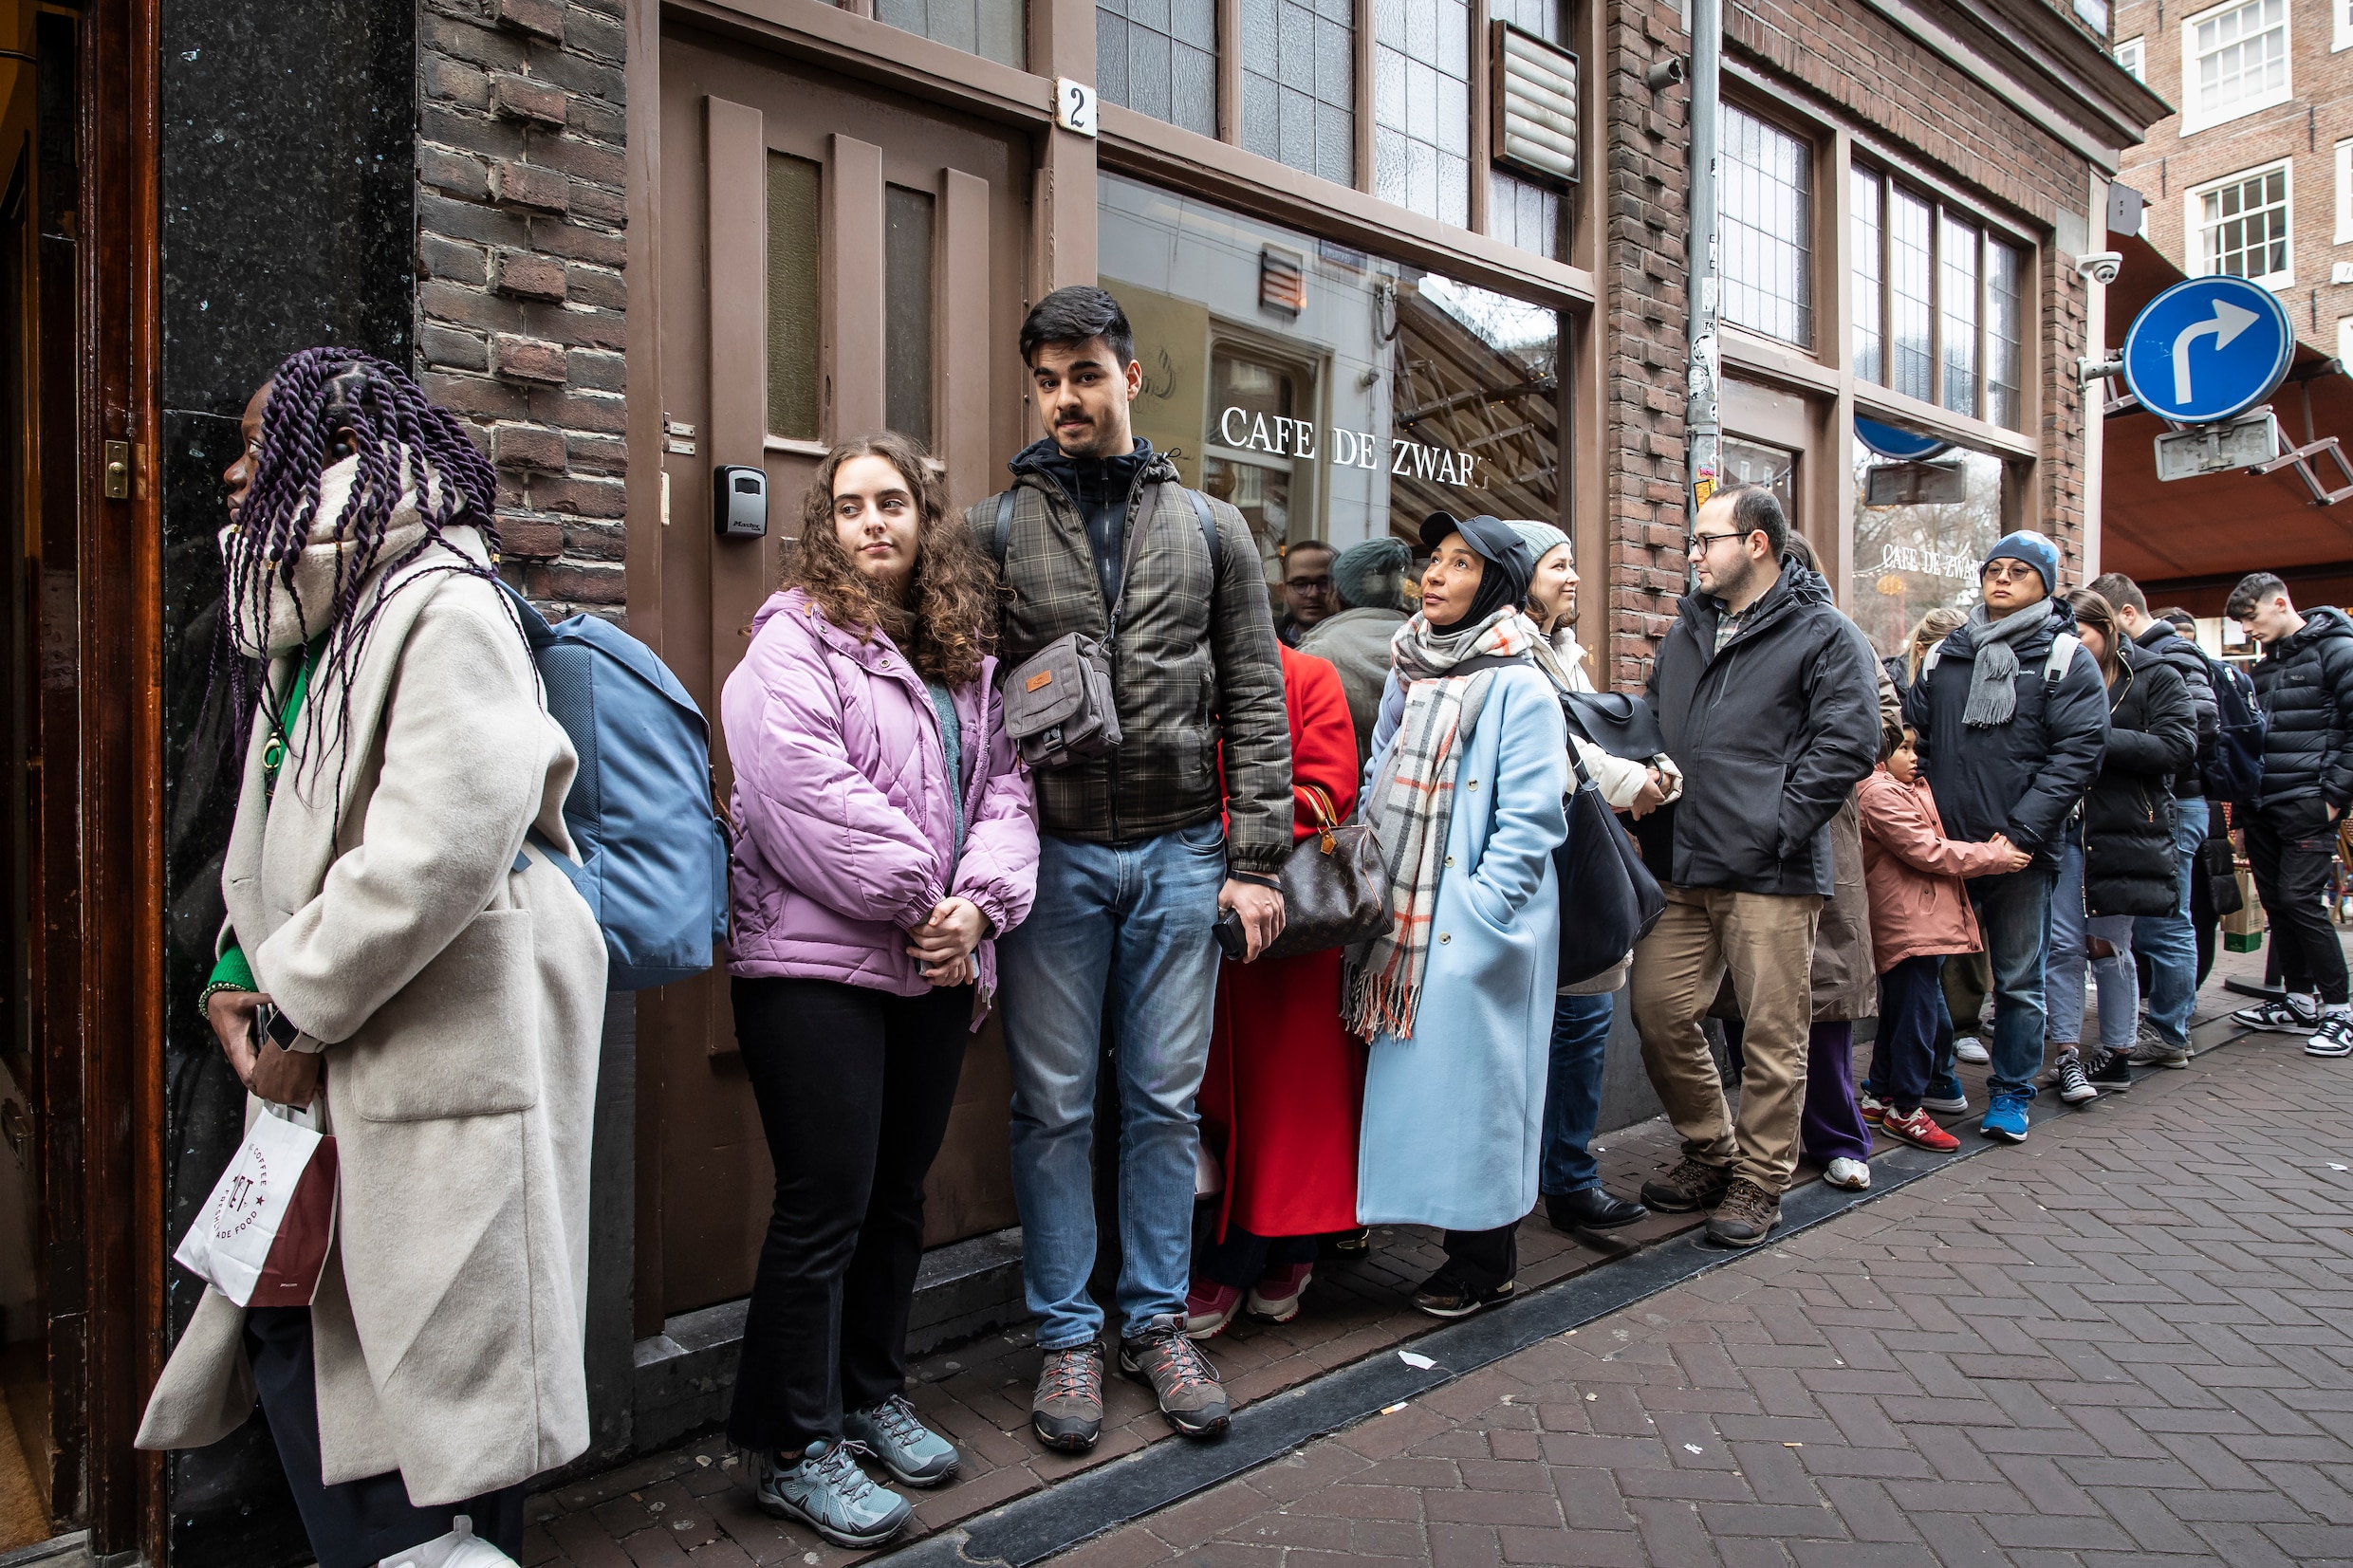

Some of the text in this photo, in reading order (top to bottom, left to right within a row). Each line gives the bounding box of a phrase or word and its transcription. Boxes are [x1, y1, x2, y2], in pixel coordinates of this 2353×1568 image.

[1070, 87, 1085, 128] 2
[1221, 406, 1316, 460] CAFE
[1333, 427, 1378, 470] DE
[1882, 544, 1918, 572] CAFE
[1922, 550, 1941, 576] DE
[253, 1148, 268, 1187] COFFEE
[216, 1230, 232, 1239] ADE
[234, 1210, 257, 1235] FOOD
